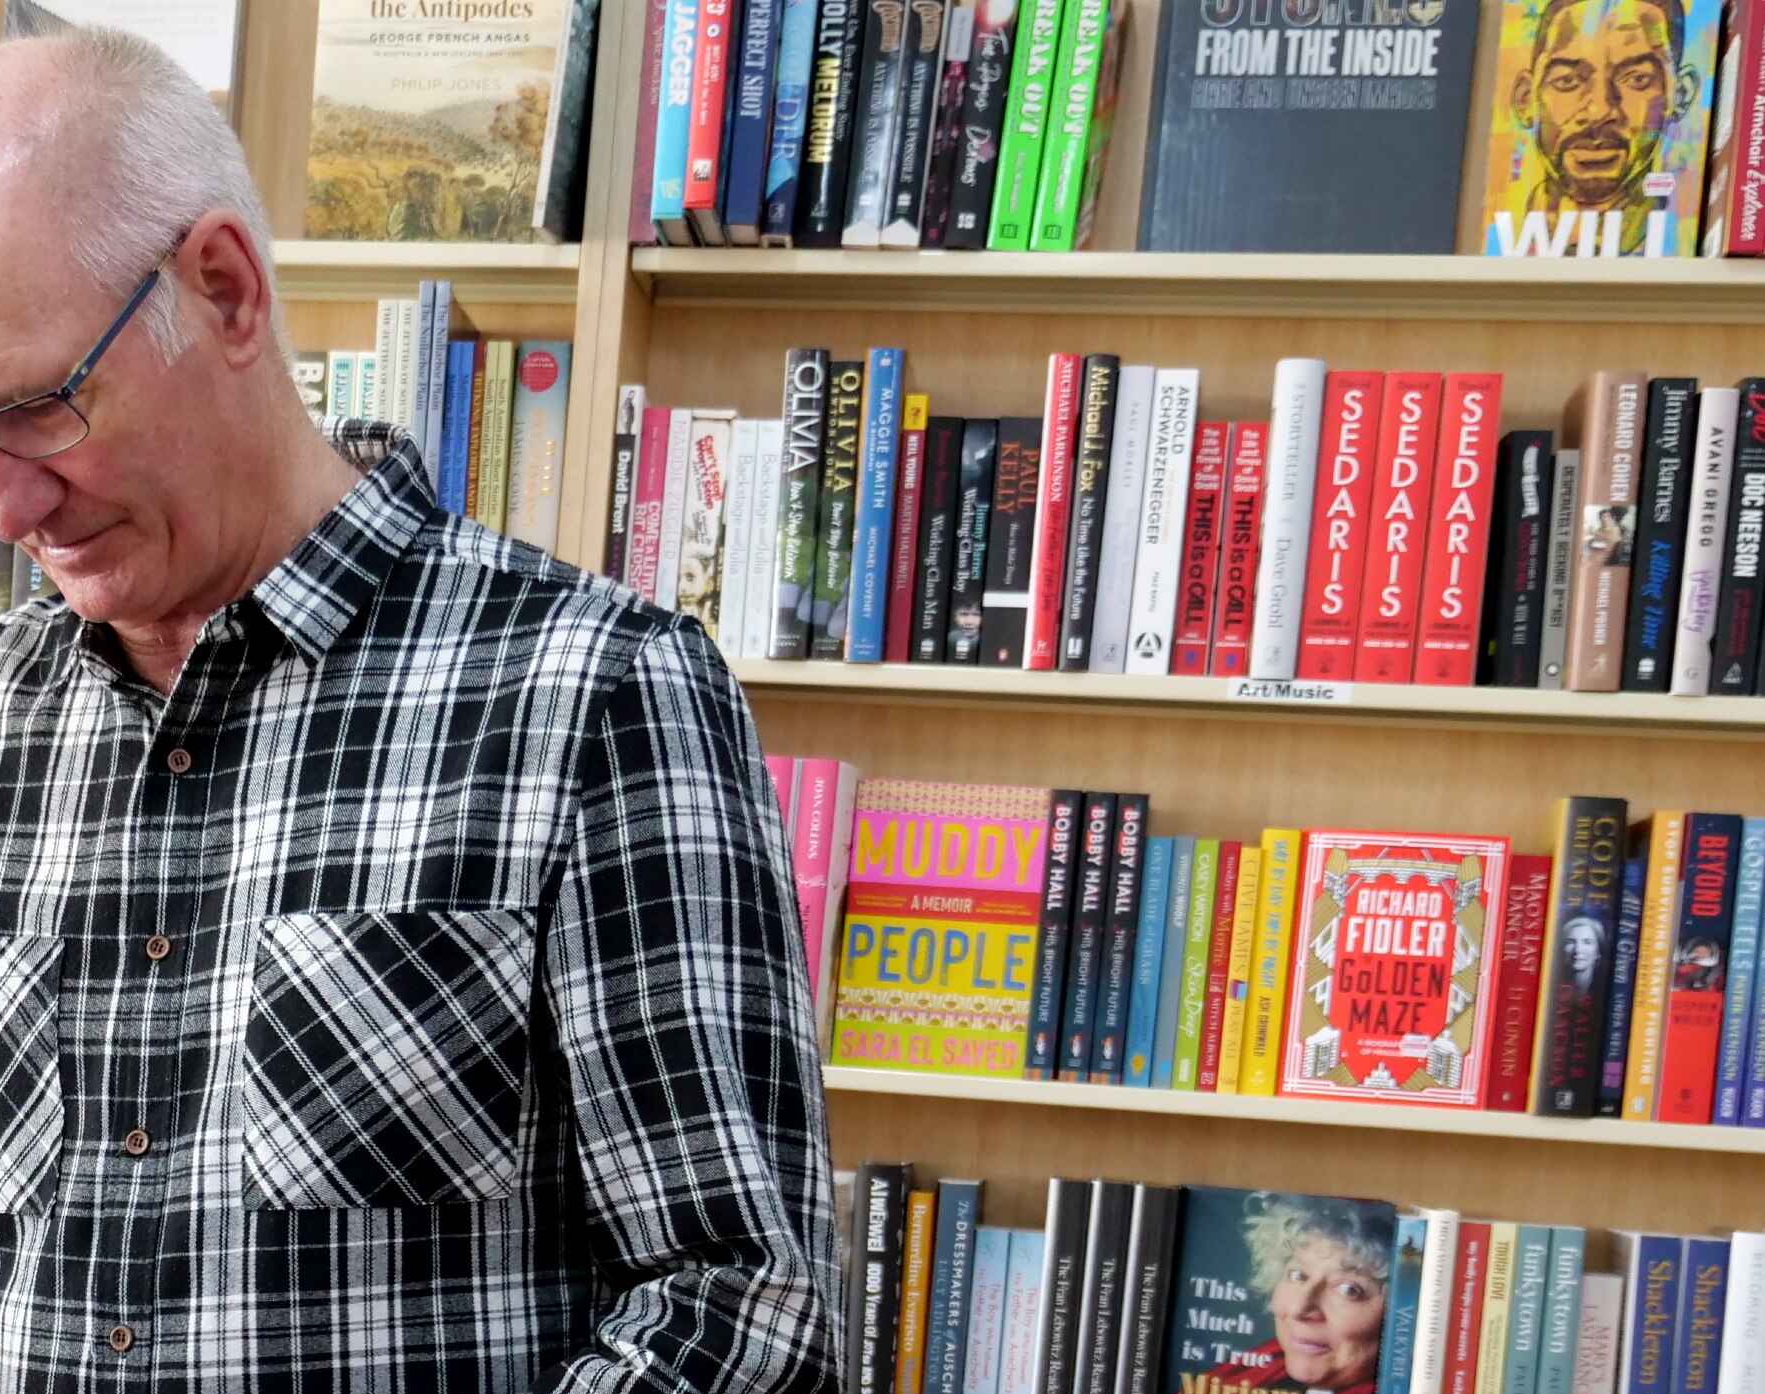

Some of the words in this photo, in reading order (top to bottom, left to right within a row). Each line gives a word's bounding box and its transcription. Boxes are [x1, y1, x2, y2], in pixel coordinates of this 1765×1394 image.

[369, 33, 423, 44] GEORGE
[427, 33, 481, 44] FRENCH
[484, 33, 530, 43] ANGAS
[666, 1, 694, 108] JAGGER
[1195, 29, 1280, 77] FROM
[1285, 29, 1337, 77] THE
[1341, 29, 1441, 77] INSIDE
[391, 78, 443, 91] PHILIP
[447, 78, 501, 91] JONES
[806, 57, 841, 165] MELDRUM
[787, 362, 827, 474] OLIVIA
[831, 368, 862, 495] OLIVIA
[875, 385, 893, 456] MAGGIE
[1084, 366, 1110, 438] Michael
[1614, 382, 1638, 451] LEONARD
[870, 458, 888, 510] SMITH
[1320, 389, 1365, 616] SEDARIS
[1377, 391, 1424, 619] SEDARIS
[1438, 392, 1485, 620] SEDARIS
[1236, 683, 1335, 701] Art/Music
[855, 818, 1042, 886] MUDDY
[1689, 833, 1729, 918] BEYOND
[921, 897, 973, 914] MEMOIR
[1346, 916, 1448, 957] FIDLER
[1356, 888, 1442, 918] RICHARD
[843, 923, 1032, 992] PEOPLE
[839, 1029, 902, 1063] SARA
[908, 1035, 936, 1065] EL
[941, 1035, 1018, 1071] SAYED
[1348, 999, 1428, 1036] MAZE
[1056, 1281, 1069, 1306] Fran
[1058, 1256, 1071, 1280] The
[1191, 1275, 1248, 1302] This
[1513, 1241, 1546, 1352] funkytown
[1547, 1245, 1582, 1354] funkytown
[1050, 1308, 1067, 1360] Lebowitz
[1188, 1304, 1254, 1336] Much
[1637, 1258, 1674, 1388] Shackleton
[1685, 1263, 1723, 1391] Shackleton
[1181, 1342, 1204, 1360] is
[1210, 1341, 1273, 1370] True
